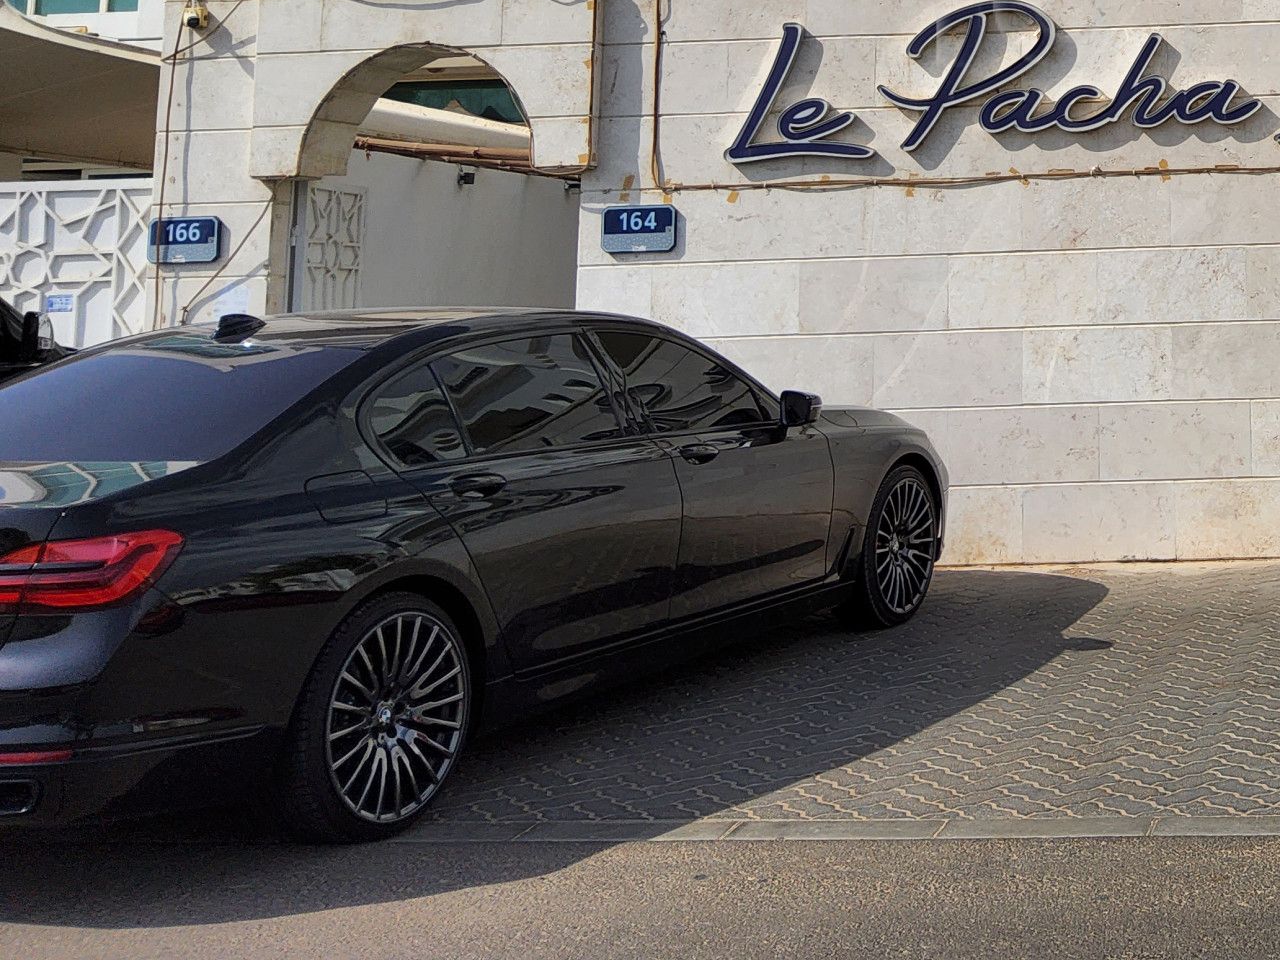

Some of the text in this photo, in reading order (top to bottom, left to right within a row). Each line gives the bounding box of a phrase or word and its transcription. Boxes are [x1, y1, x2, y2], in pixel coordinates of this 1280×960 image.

[724, 22, 876, 164] Le
[877, 0, 1262, 152] Pacha
[619, 211, 657, 231] 164
[166, 222, 200, 242] 166
